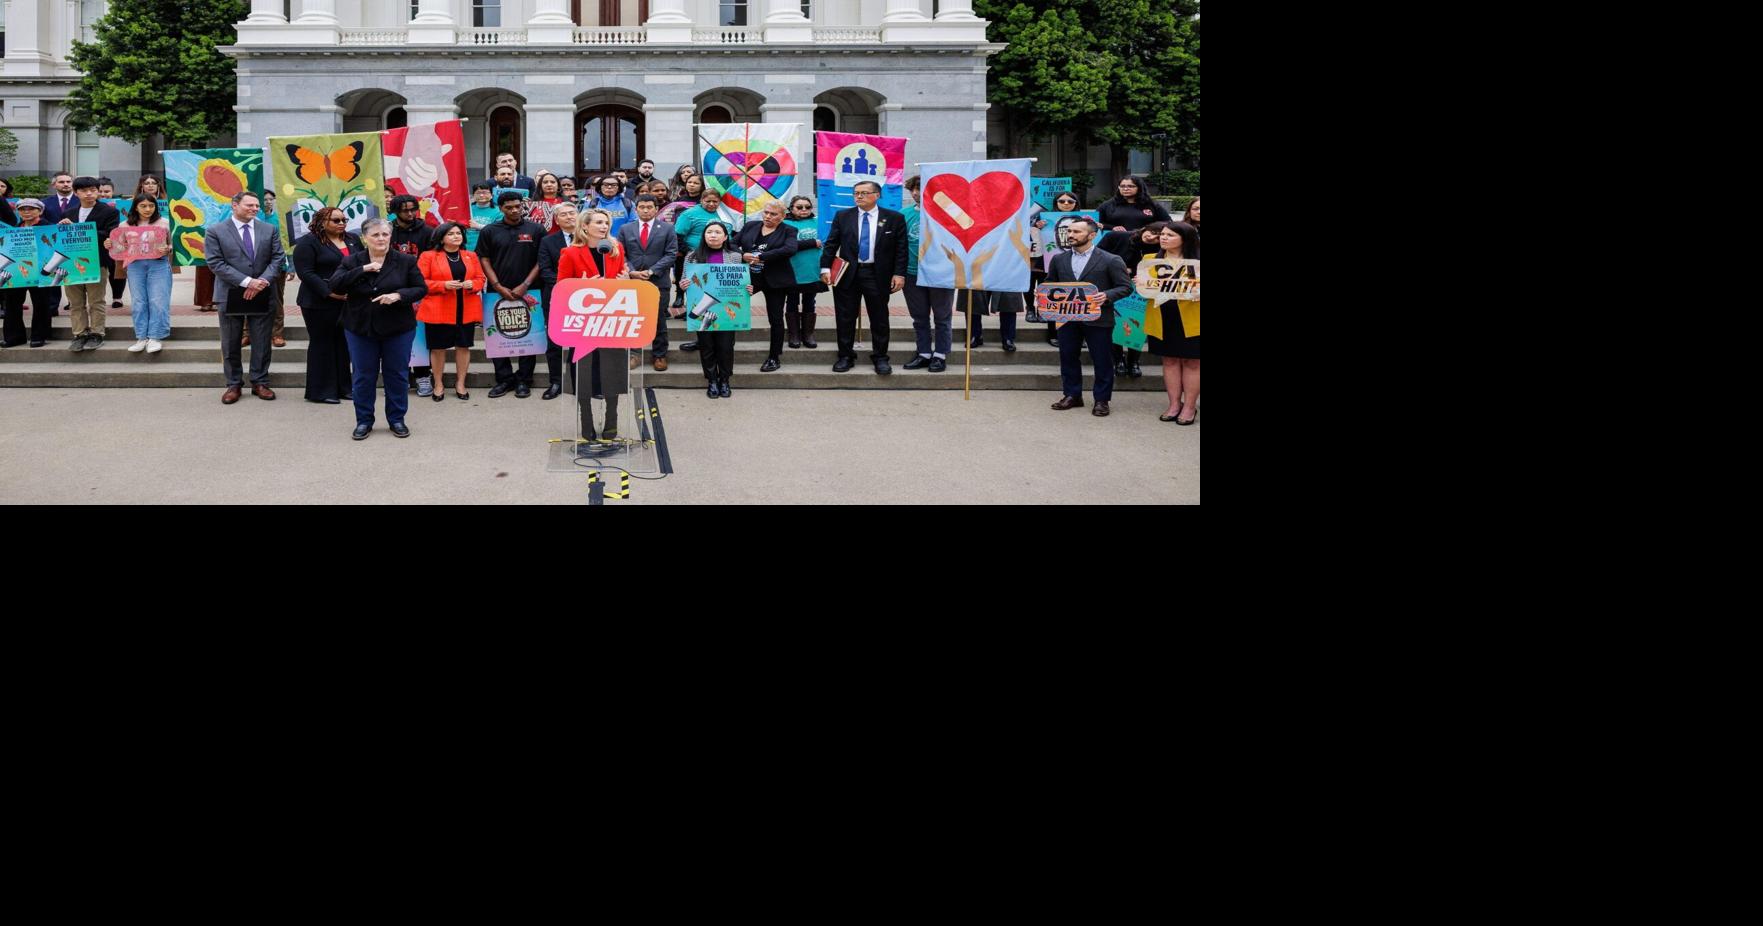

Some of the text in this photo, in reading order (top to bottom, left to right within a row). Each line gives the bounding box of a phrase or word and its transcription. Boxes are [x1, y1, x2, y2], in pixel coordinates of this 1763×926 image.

[58, 223, 94, 232] CALIFORNIA
[61, 236, 92, 245] EVERYONE
[1148, 264, 1196, 279] CA
[1047, 288, 1088, 301] CA
[568, 287, 640, 315] CA
[1059, 302, 1092, 314] HATE
[498, 314, 528, 326] VOICE
[563, 315, 645, 338] VS HATE
